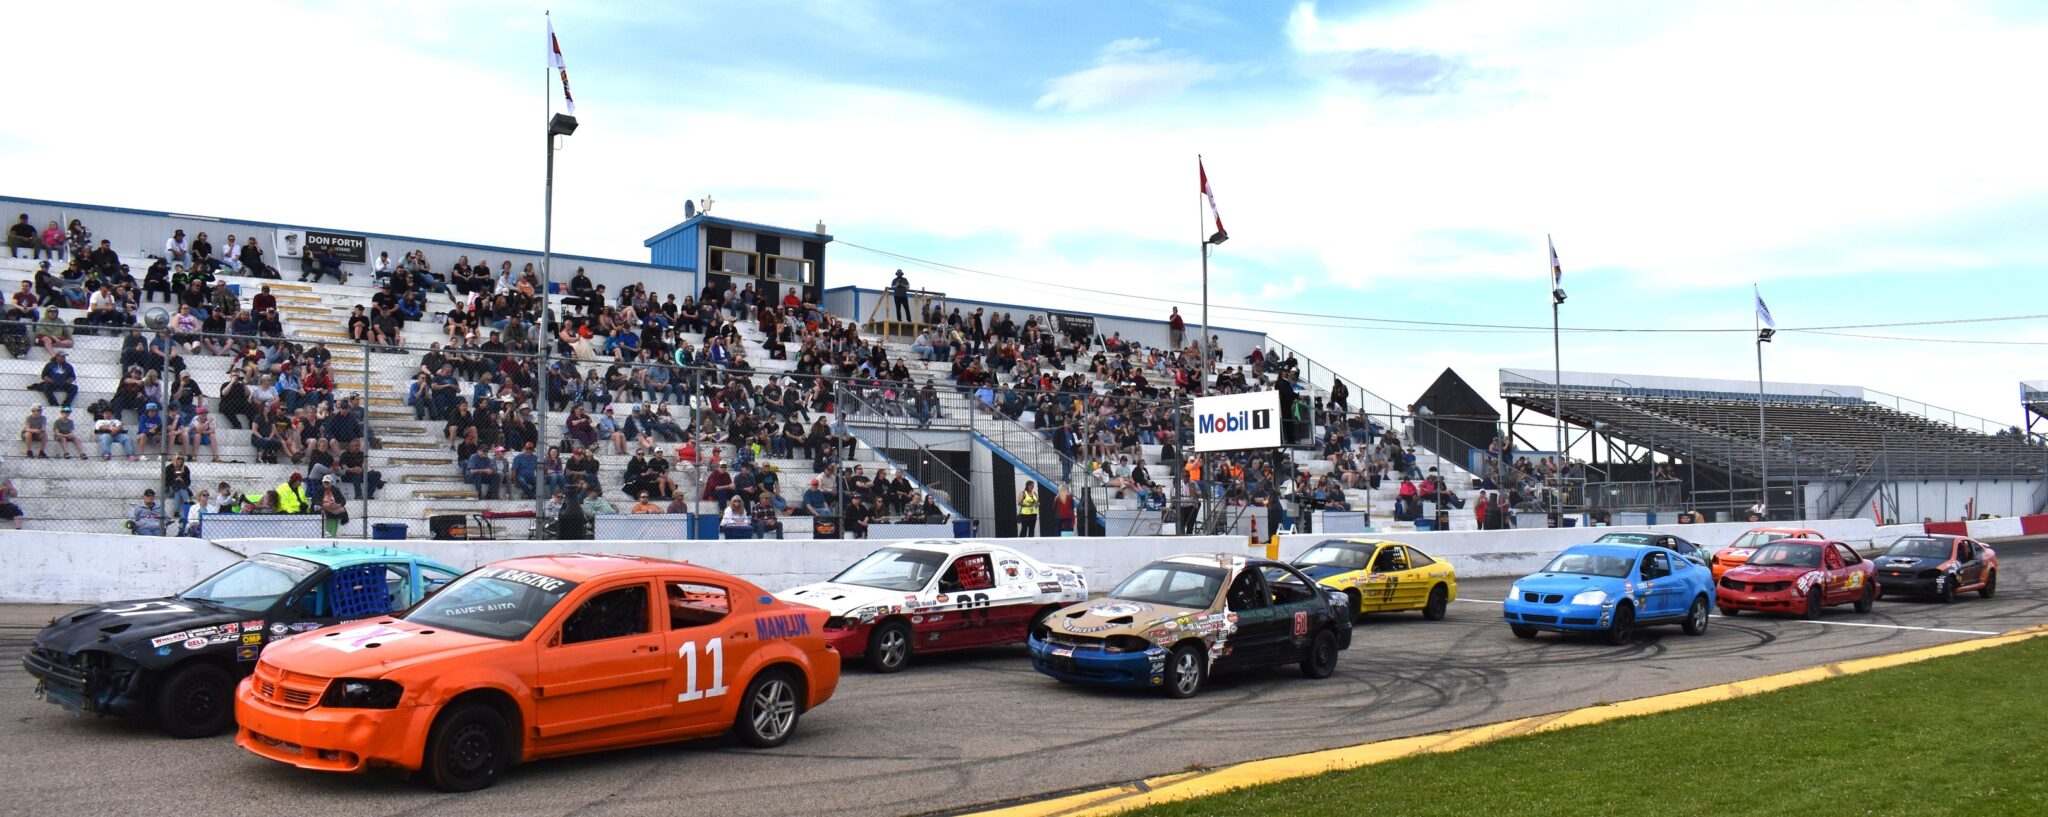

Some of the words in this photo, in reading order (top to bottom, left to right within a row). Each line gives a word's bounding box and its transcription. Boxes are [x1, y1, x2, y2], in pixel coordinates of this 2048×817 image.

[308, 235, 330, 245] DON
[331, 238, 363, 248] FORTH
[1199, 410, 1249, 434] Mobil
[497, 569, 566, 591] RACING
[445, 605, 484, 616] DAVE'S
[487, 602, 516, 611] AUTO
[755, 613, 810, 640] MANLUK
[187, 639, 205, 647] BELL
[242, 634, 261, 643] OMP
[678, 637, 730, 702] 11
